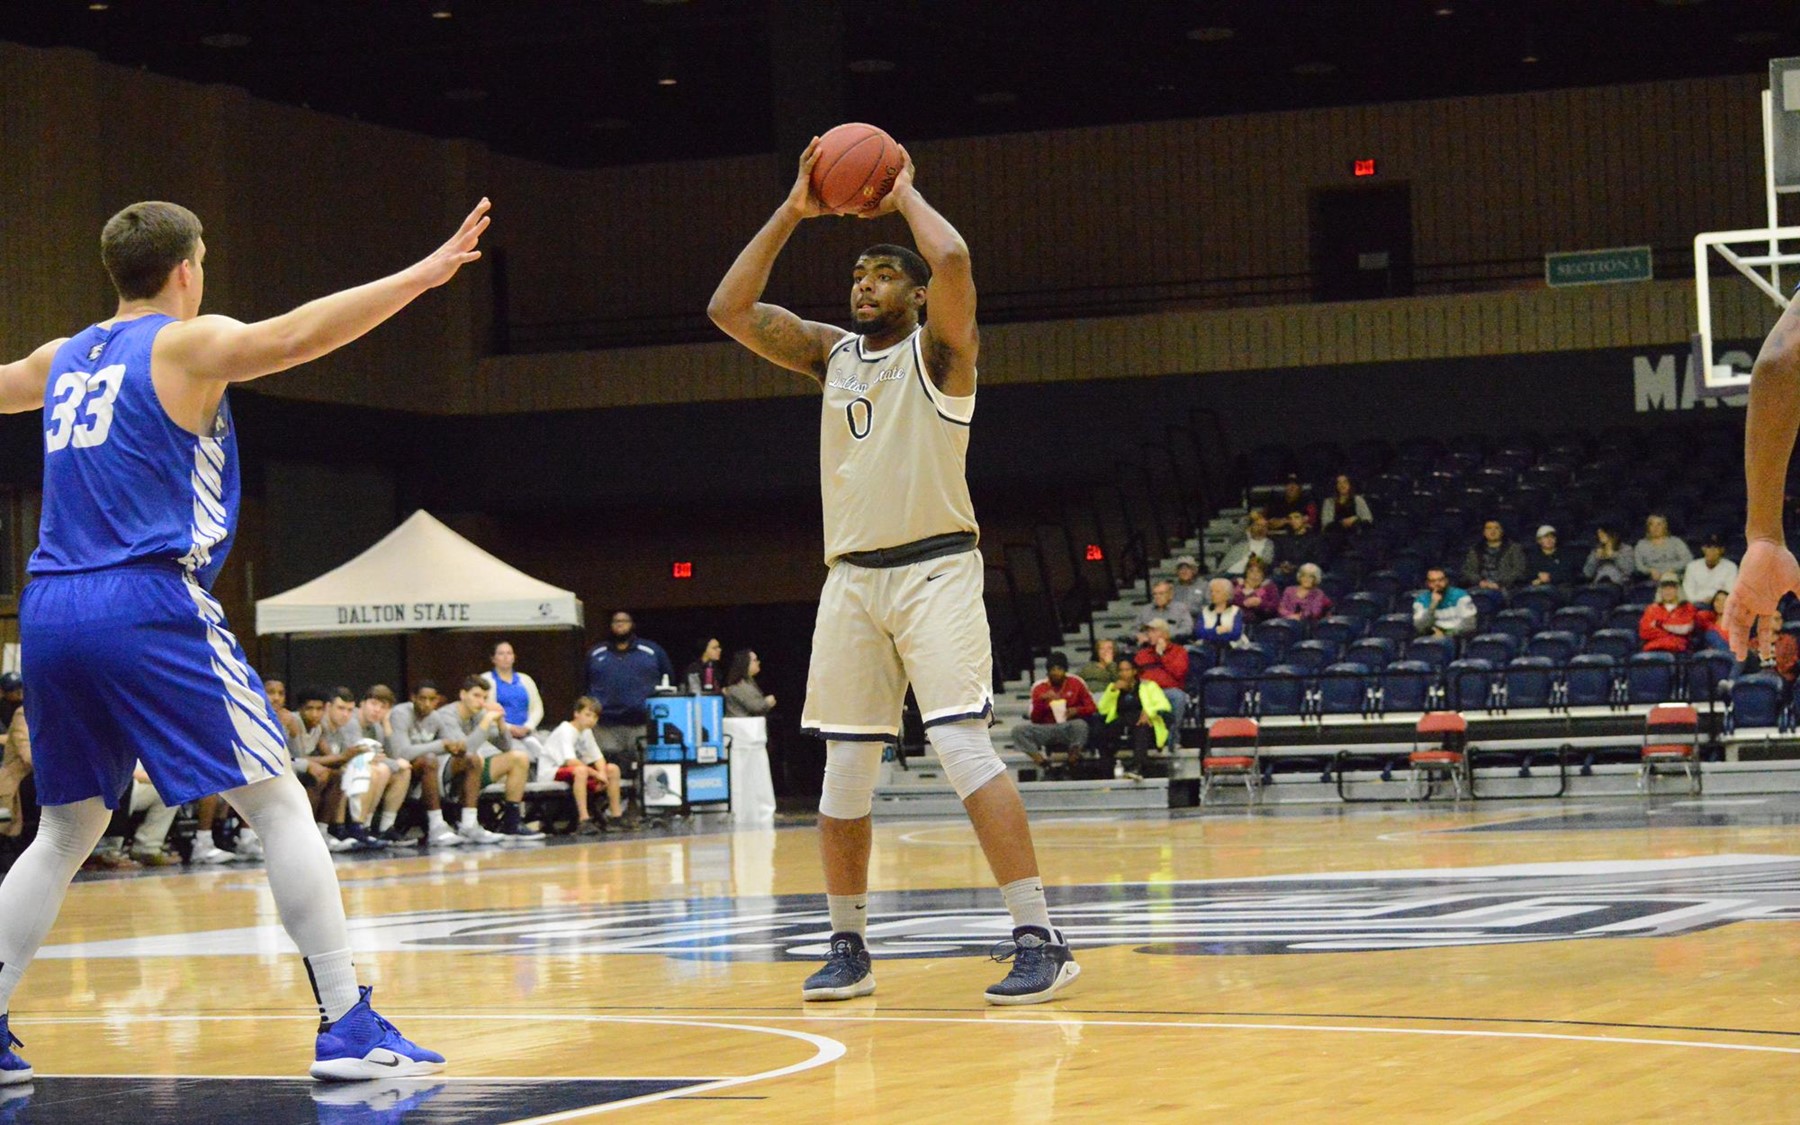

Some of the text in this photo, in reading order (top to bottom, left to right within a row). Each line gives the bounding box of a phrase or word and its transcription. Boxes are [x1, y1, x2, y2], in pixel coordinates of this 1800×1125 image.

[1556, 258, 1630, 276] SECTION
[873, 366, 905, 384] tate
[46, 363, 127, 454] 33
[845, 395, 873, 441] 0
[337, 603, 470, 625] DALTON STATE
